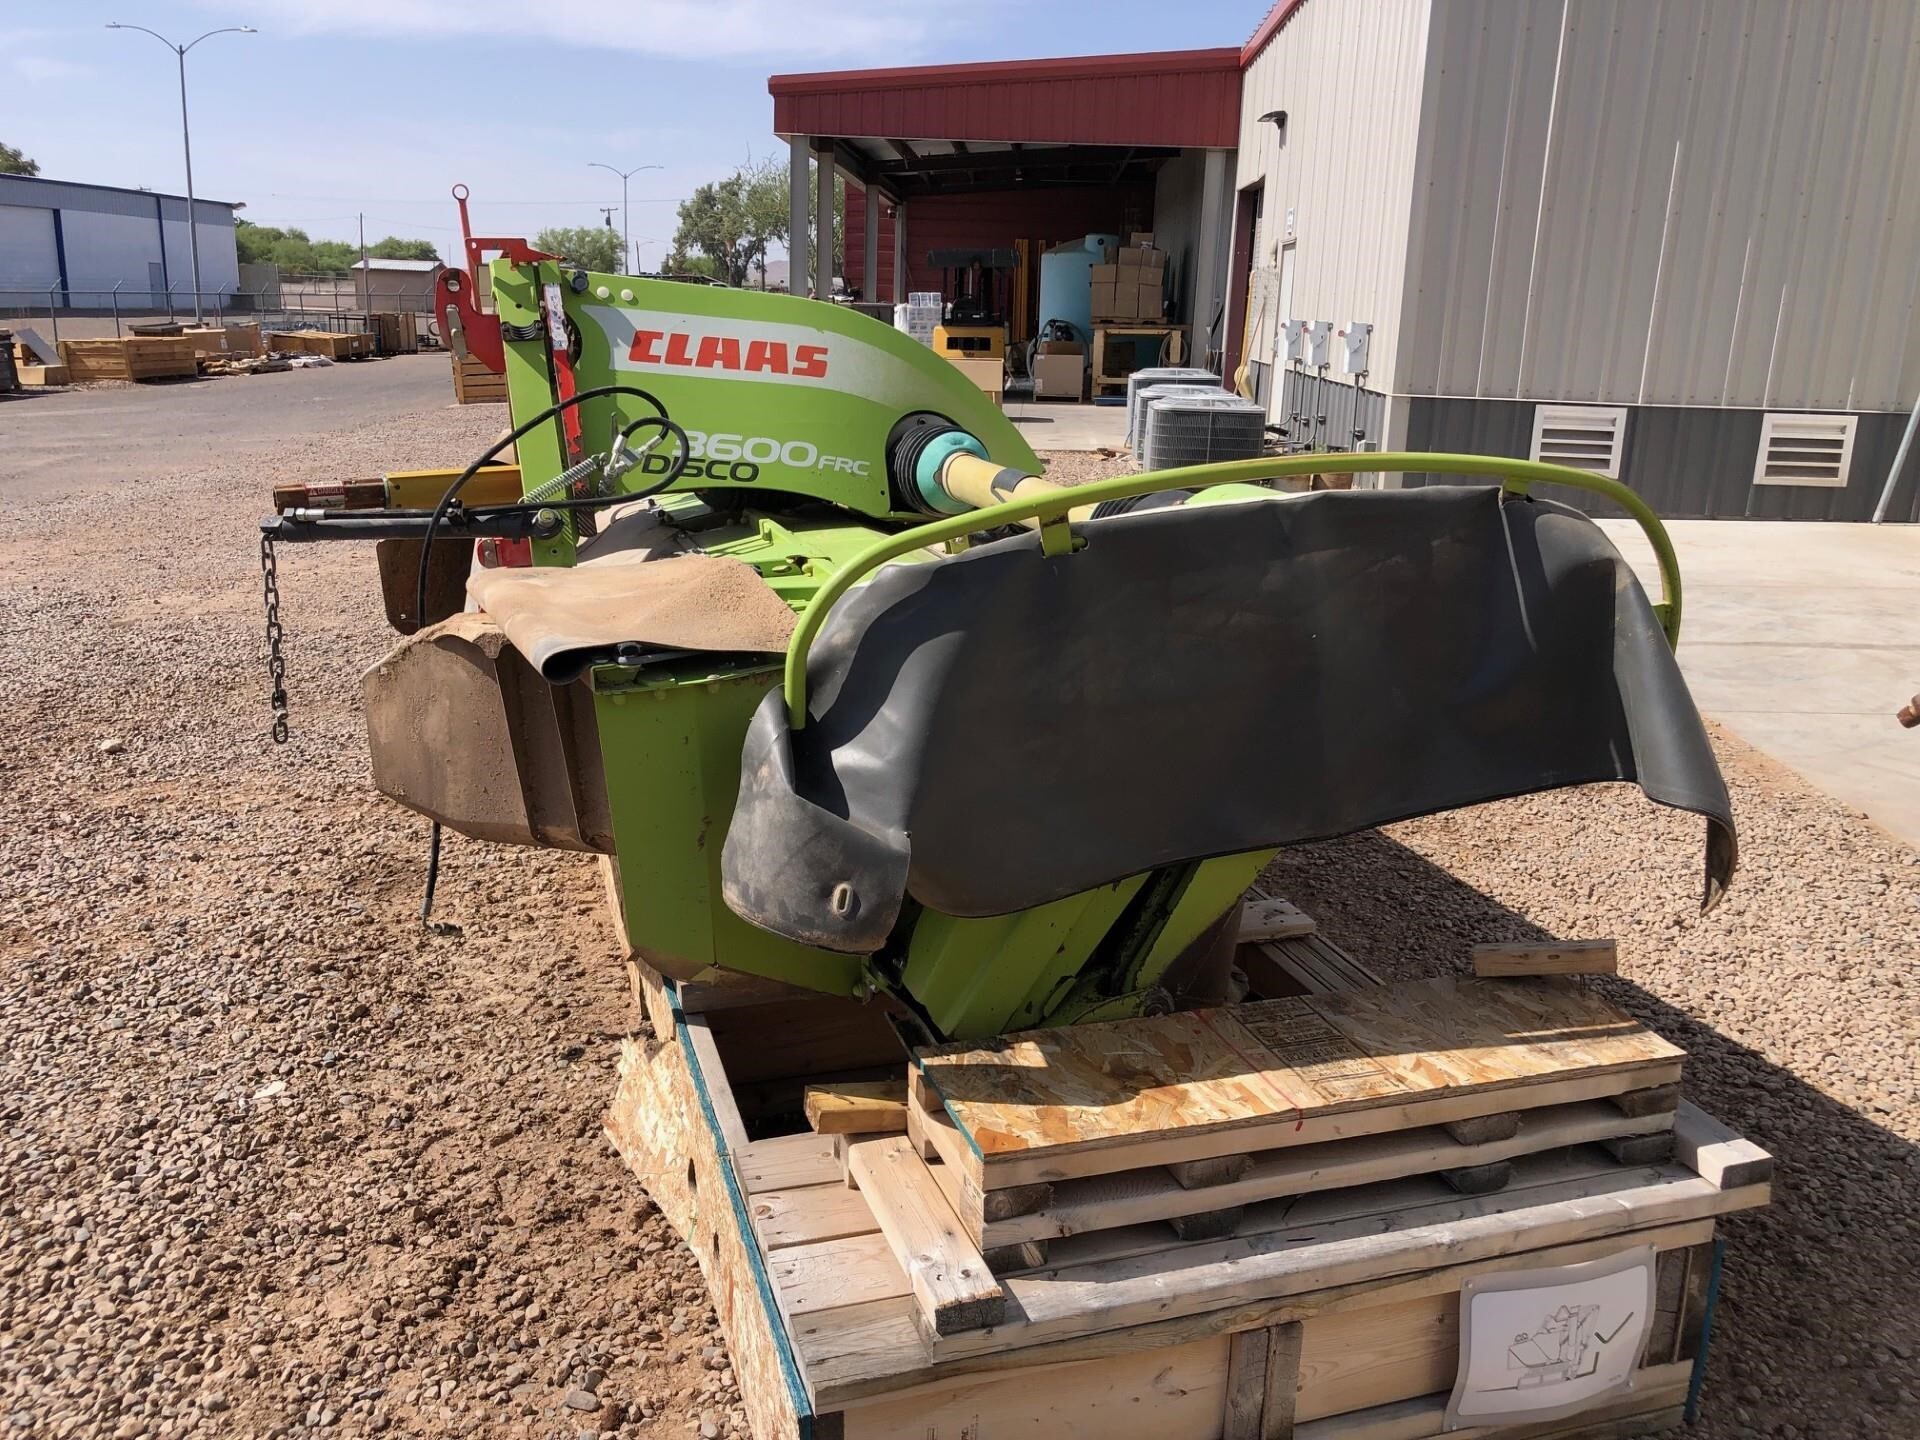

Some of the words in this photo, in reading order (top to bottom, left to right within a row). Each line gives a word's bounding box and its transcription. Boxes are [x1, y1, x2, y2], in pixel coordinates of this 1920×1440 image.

[629, 330, 828, 378] CLAAS
[641, 454, 760, 482] DISCO
[673, 431, 818, 467] 3600
[818, 455, 870, 476] FRC
